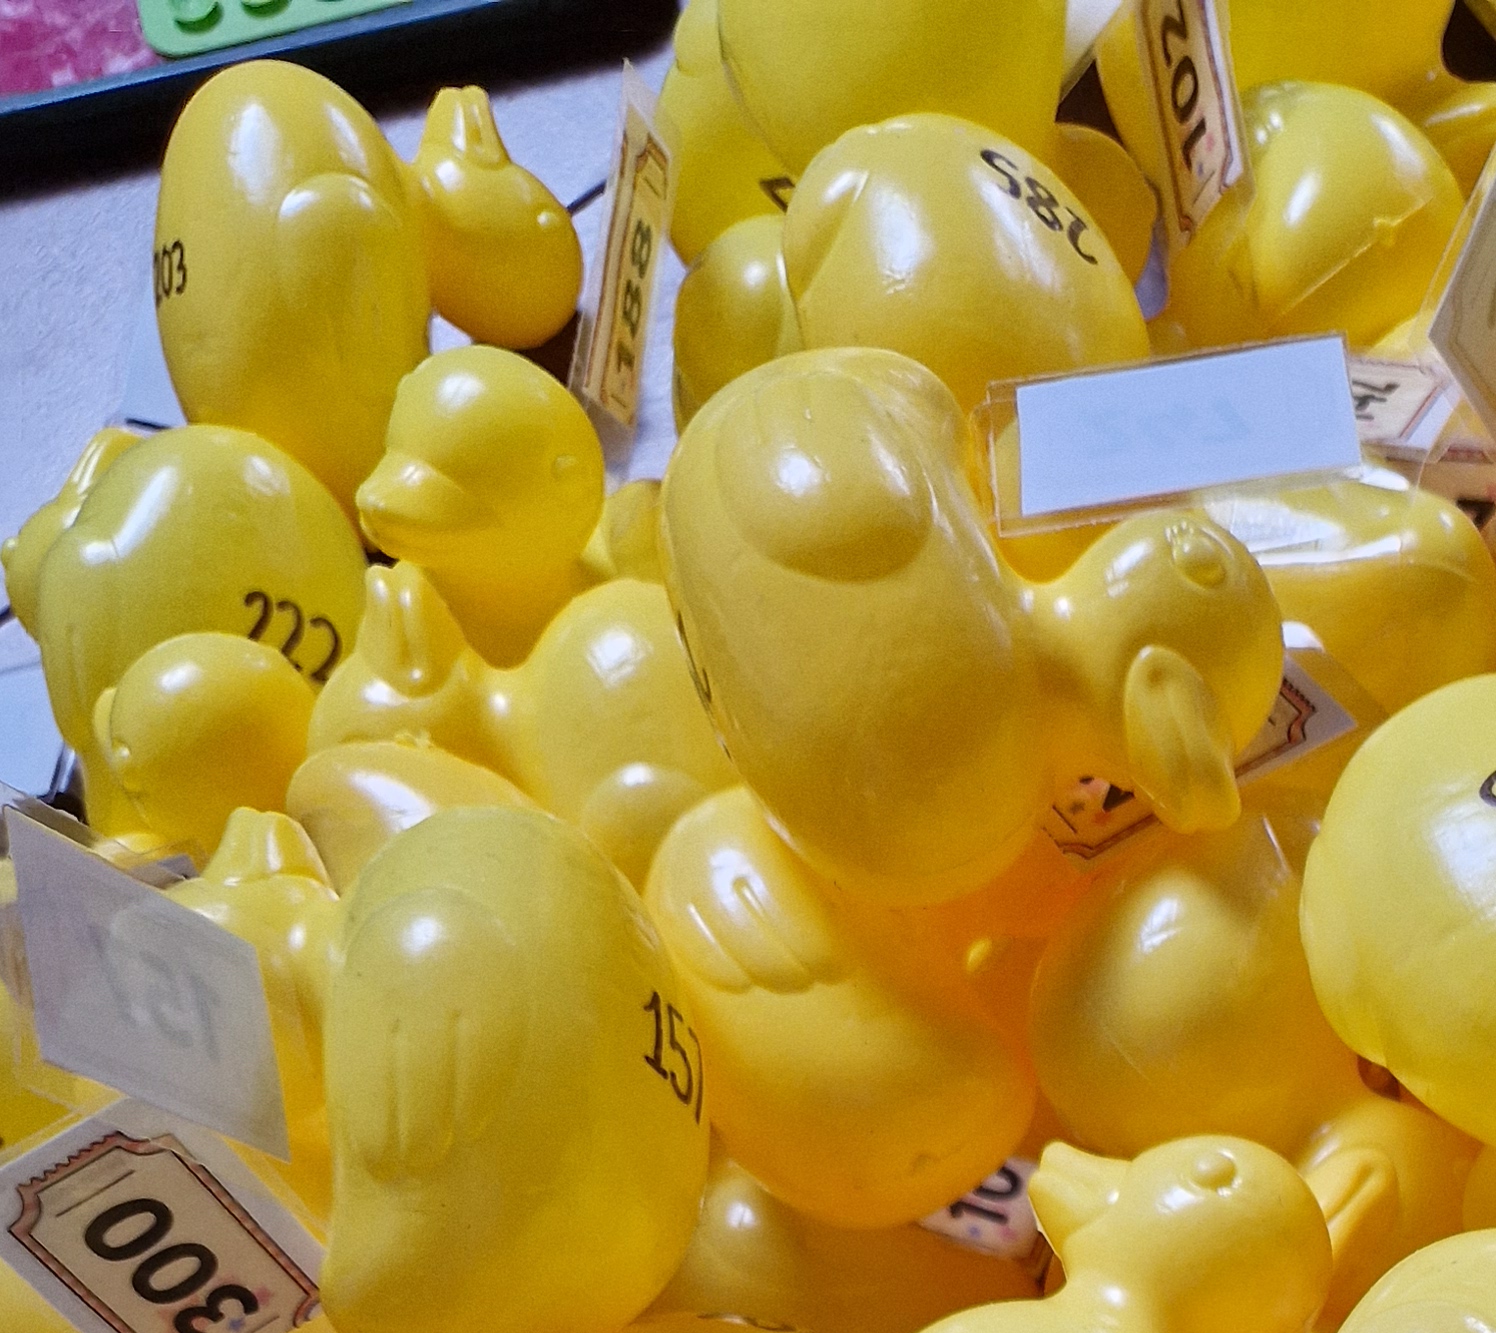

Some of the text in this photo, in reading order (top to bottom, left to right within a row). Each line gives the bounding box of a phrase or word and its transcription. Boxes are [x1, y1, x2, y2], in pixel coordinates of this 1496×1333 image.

[1161, 0, 1207, 173] 102
[979, 148, 1098, 265] 285
[611, 219, 653, 378] 188
